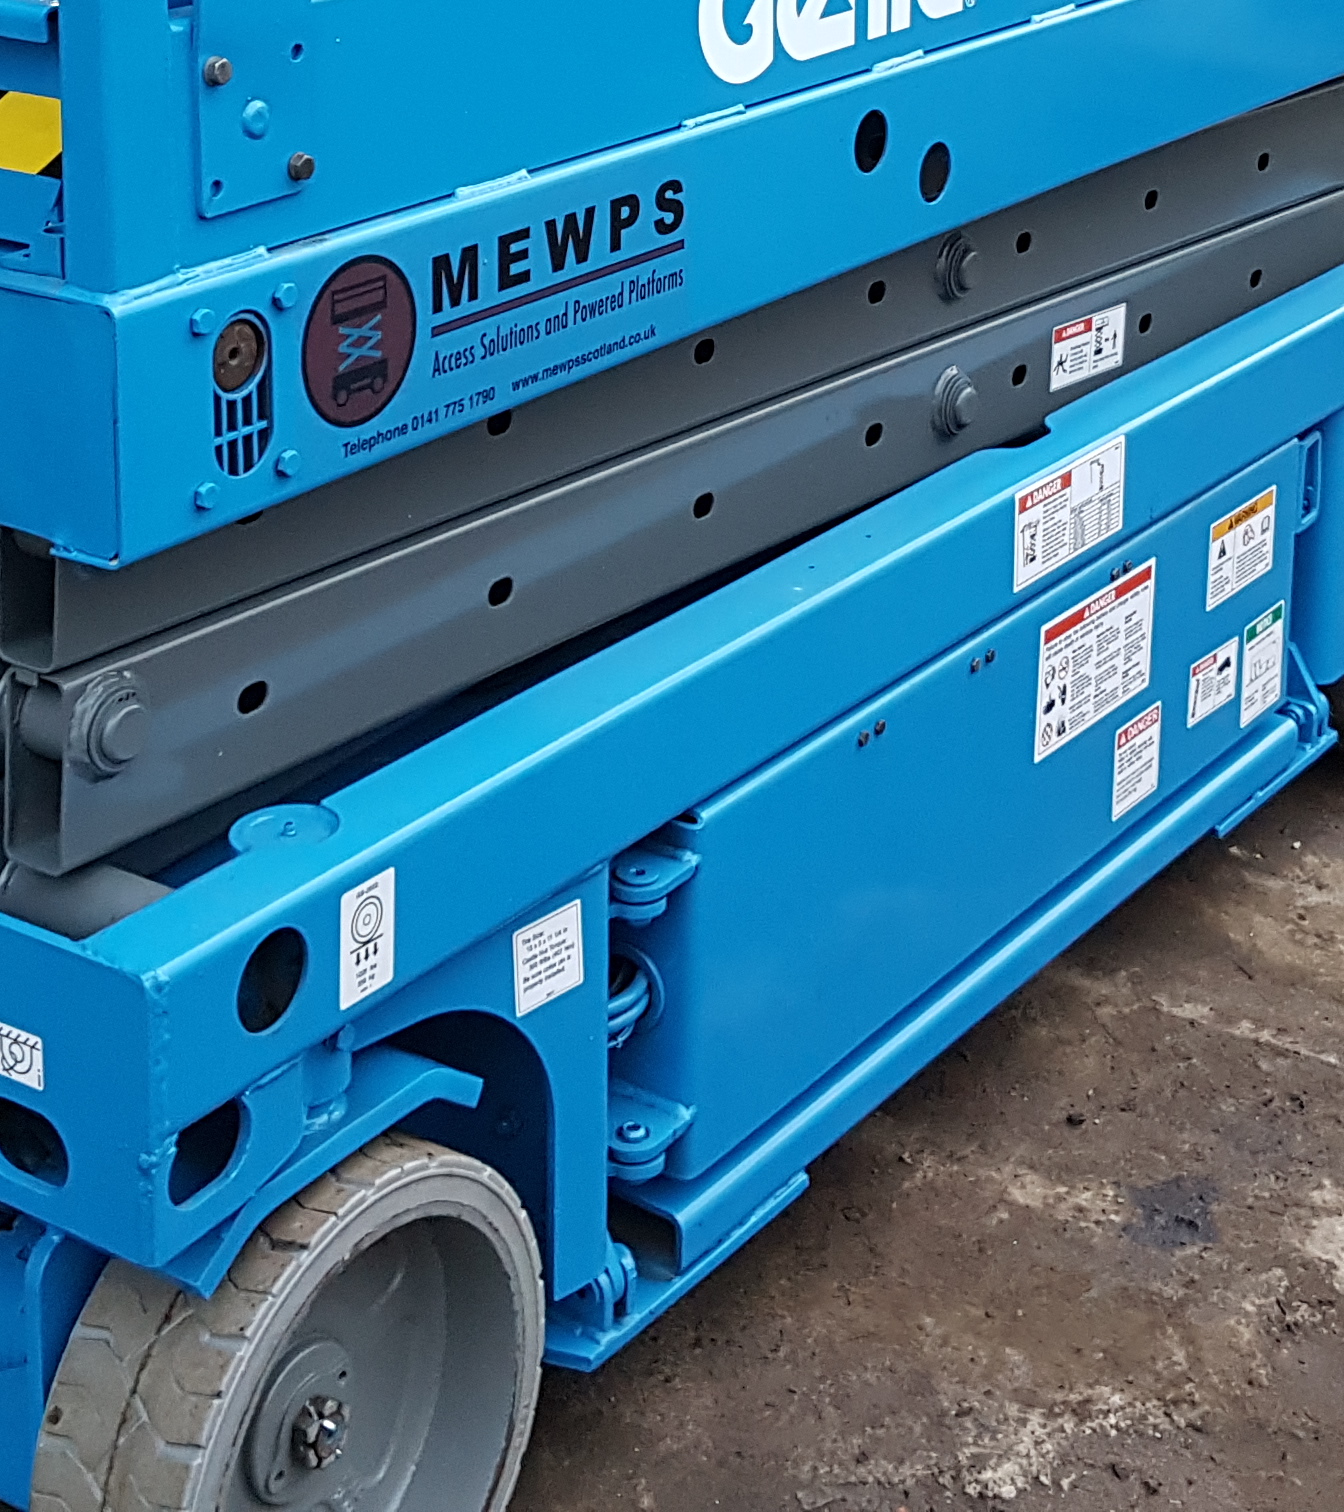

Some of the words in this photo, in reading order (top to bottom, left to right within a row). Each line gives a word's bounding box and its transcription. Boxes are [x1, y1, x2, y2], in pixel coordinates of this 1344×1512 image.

[431, 178, 685, 315] MEWPS
[432, 345, 475, 378] Access
[480, 321, 541, 360] Solutions
[544, 301, 568, 336] and
[573, 281, 624, 325] Powered
[628, 268, 684, 306] Platforms
[343, 421, 409, 458] Telephone
[411, 407, 440, 433] 0141
[443, 398, 465, 420] 775
[468, 386, 496, 411] 1790
[511, 325, 657, 392] www.mewpsscotland.co.uk
[1032, 478, 1062, 505] DANGER
